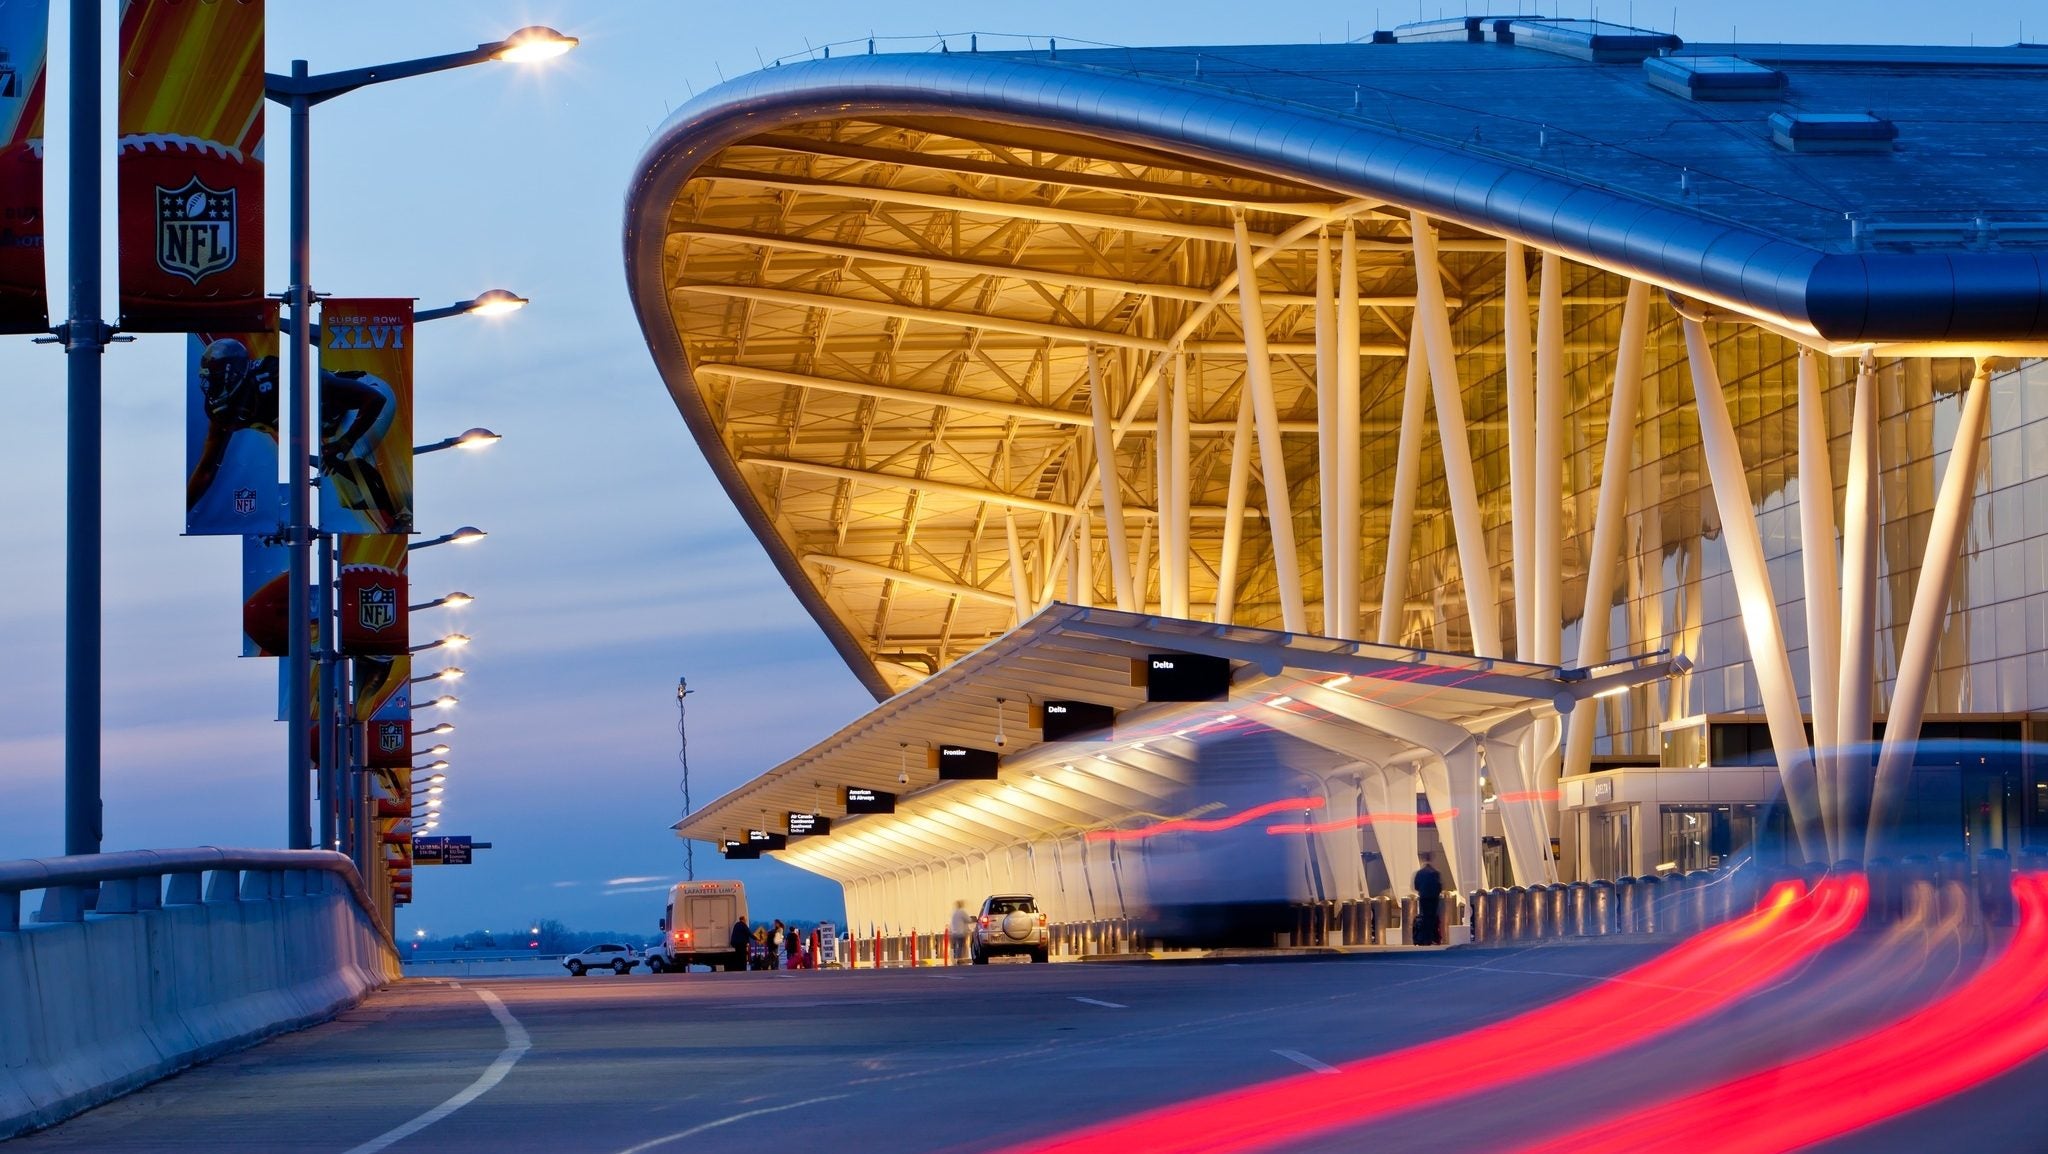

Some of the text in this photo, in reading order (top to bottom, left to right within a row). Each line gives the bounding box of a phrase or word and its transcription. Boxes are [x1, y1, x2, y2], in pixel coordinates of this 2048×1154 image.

[165, 223, 227, 268] NFL
[329, 316, 403, 324] SUPER BOWL
[328, 325, 404, 349] XLVI
[236, 499, 255, 512] NFL
[362, 604, 393, 627] NFL
[1153, 660, 1174, 669] Delta
[1048, 705, 1067, 713] Delta
[382, 735, 402, 751] NFL
